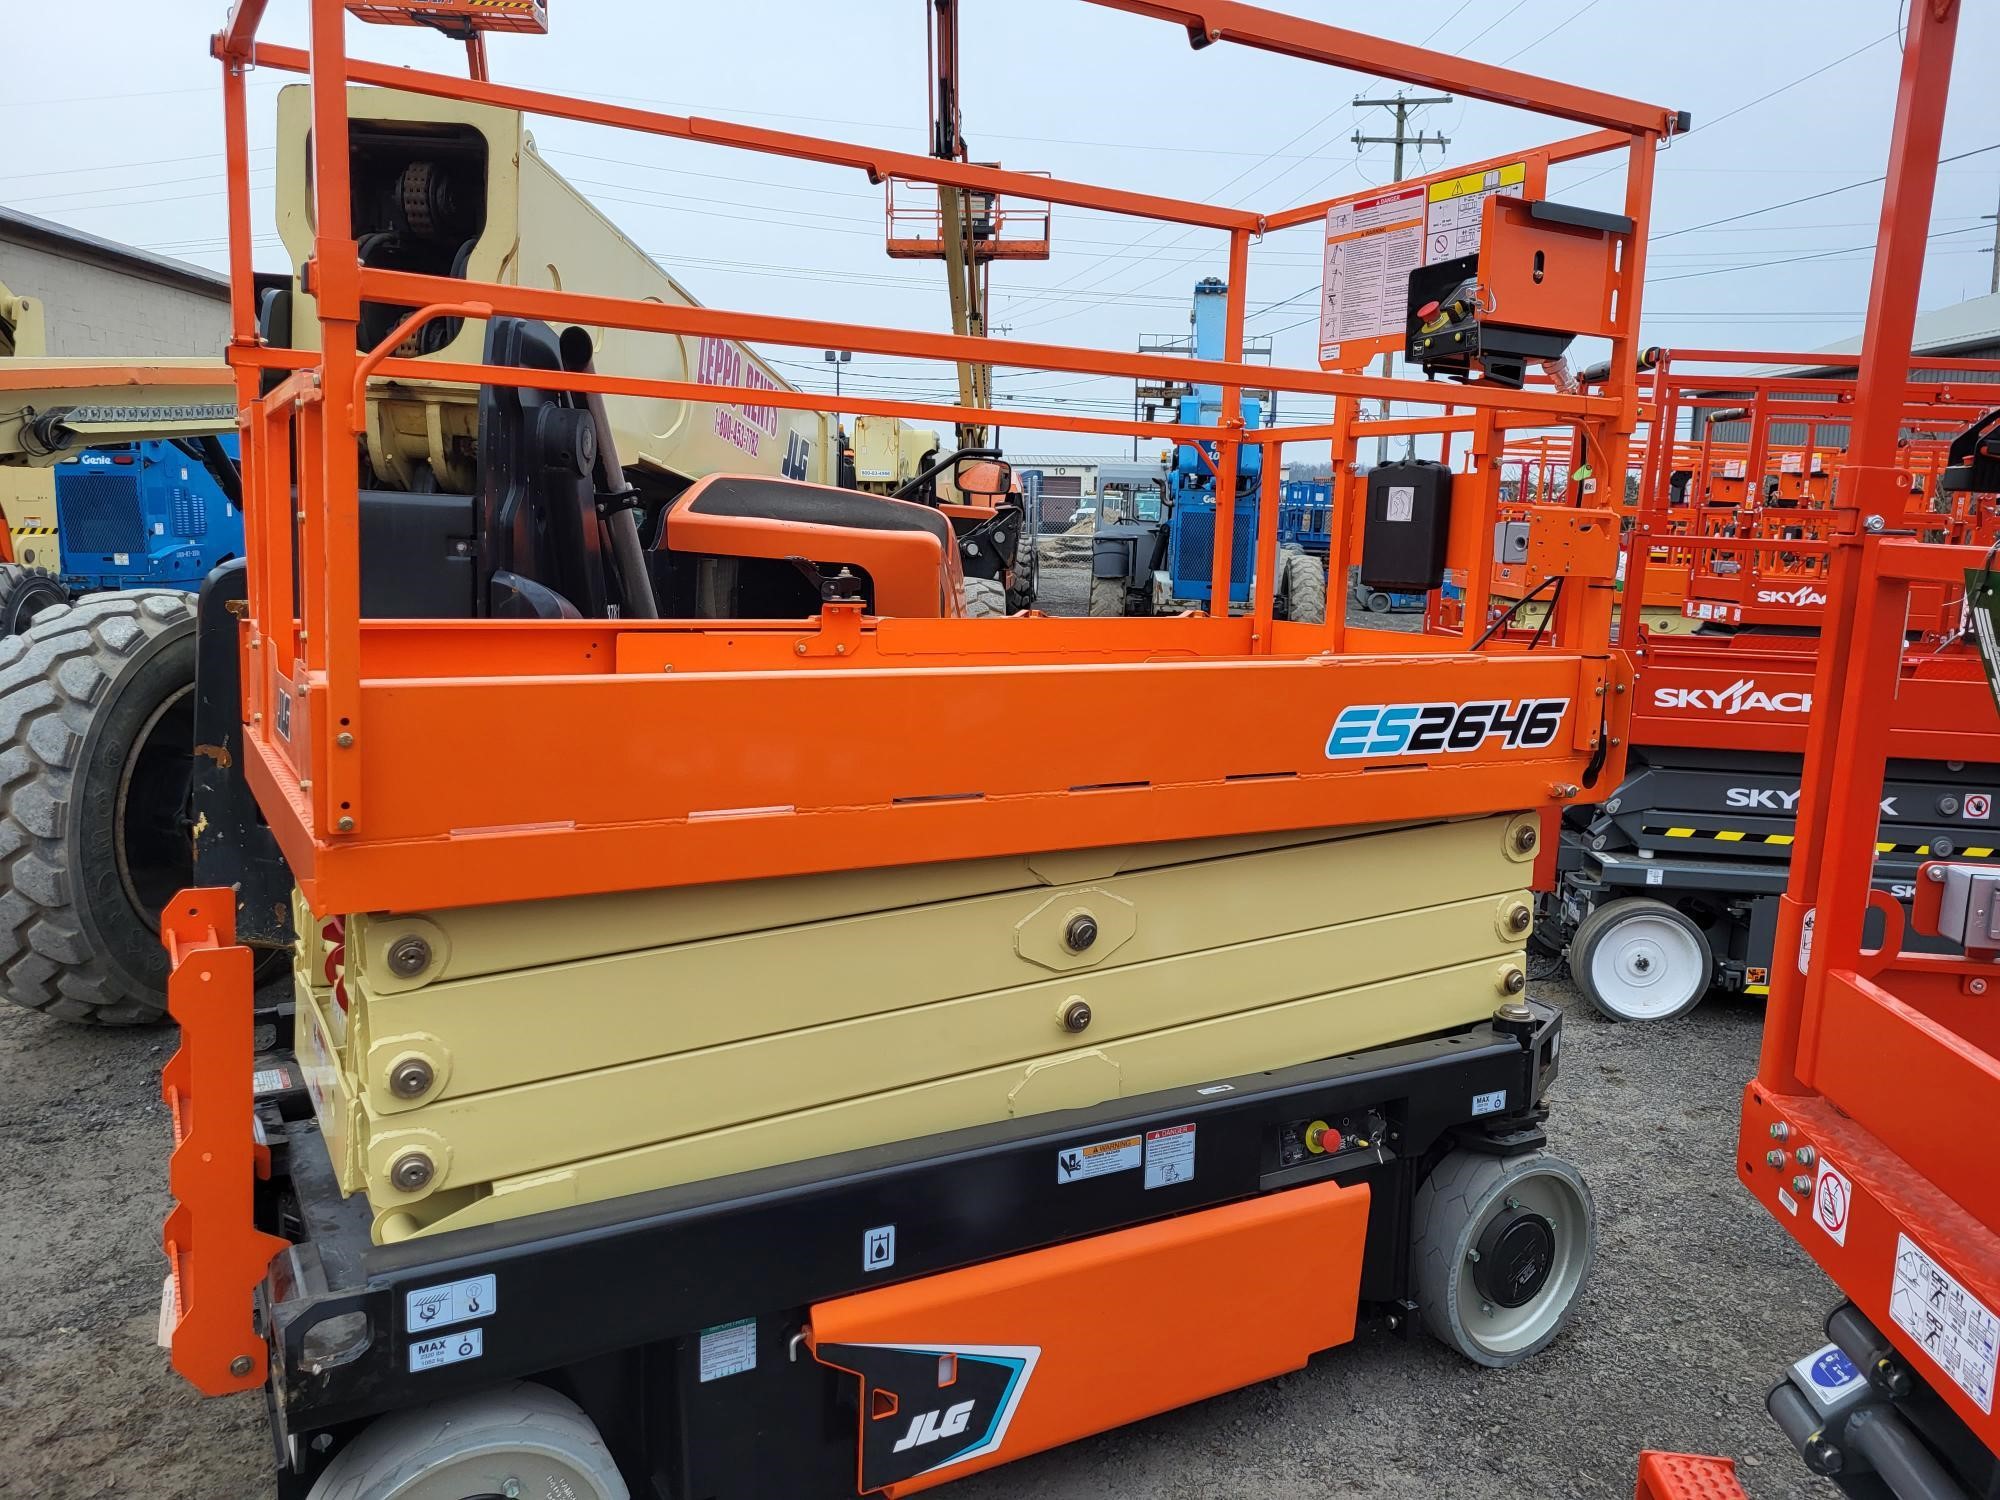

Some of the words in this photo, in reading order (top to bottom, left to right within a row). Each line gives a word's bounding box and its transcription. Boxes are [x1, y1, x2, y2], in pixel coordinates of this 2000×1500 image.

[81, 454, 113, 466] Genie
[1054, 467, 1066, 476] 10
[1757, 586, 1827, 607] SKYJA
[1325, 698, 1569, 759] ES2646
[1100, 1139, 1133, 1152] WARNING
[418, 1340, 447, 1354] MAX
[893, 1400, 975, 1453] JLG
